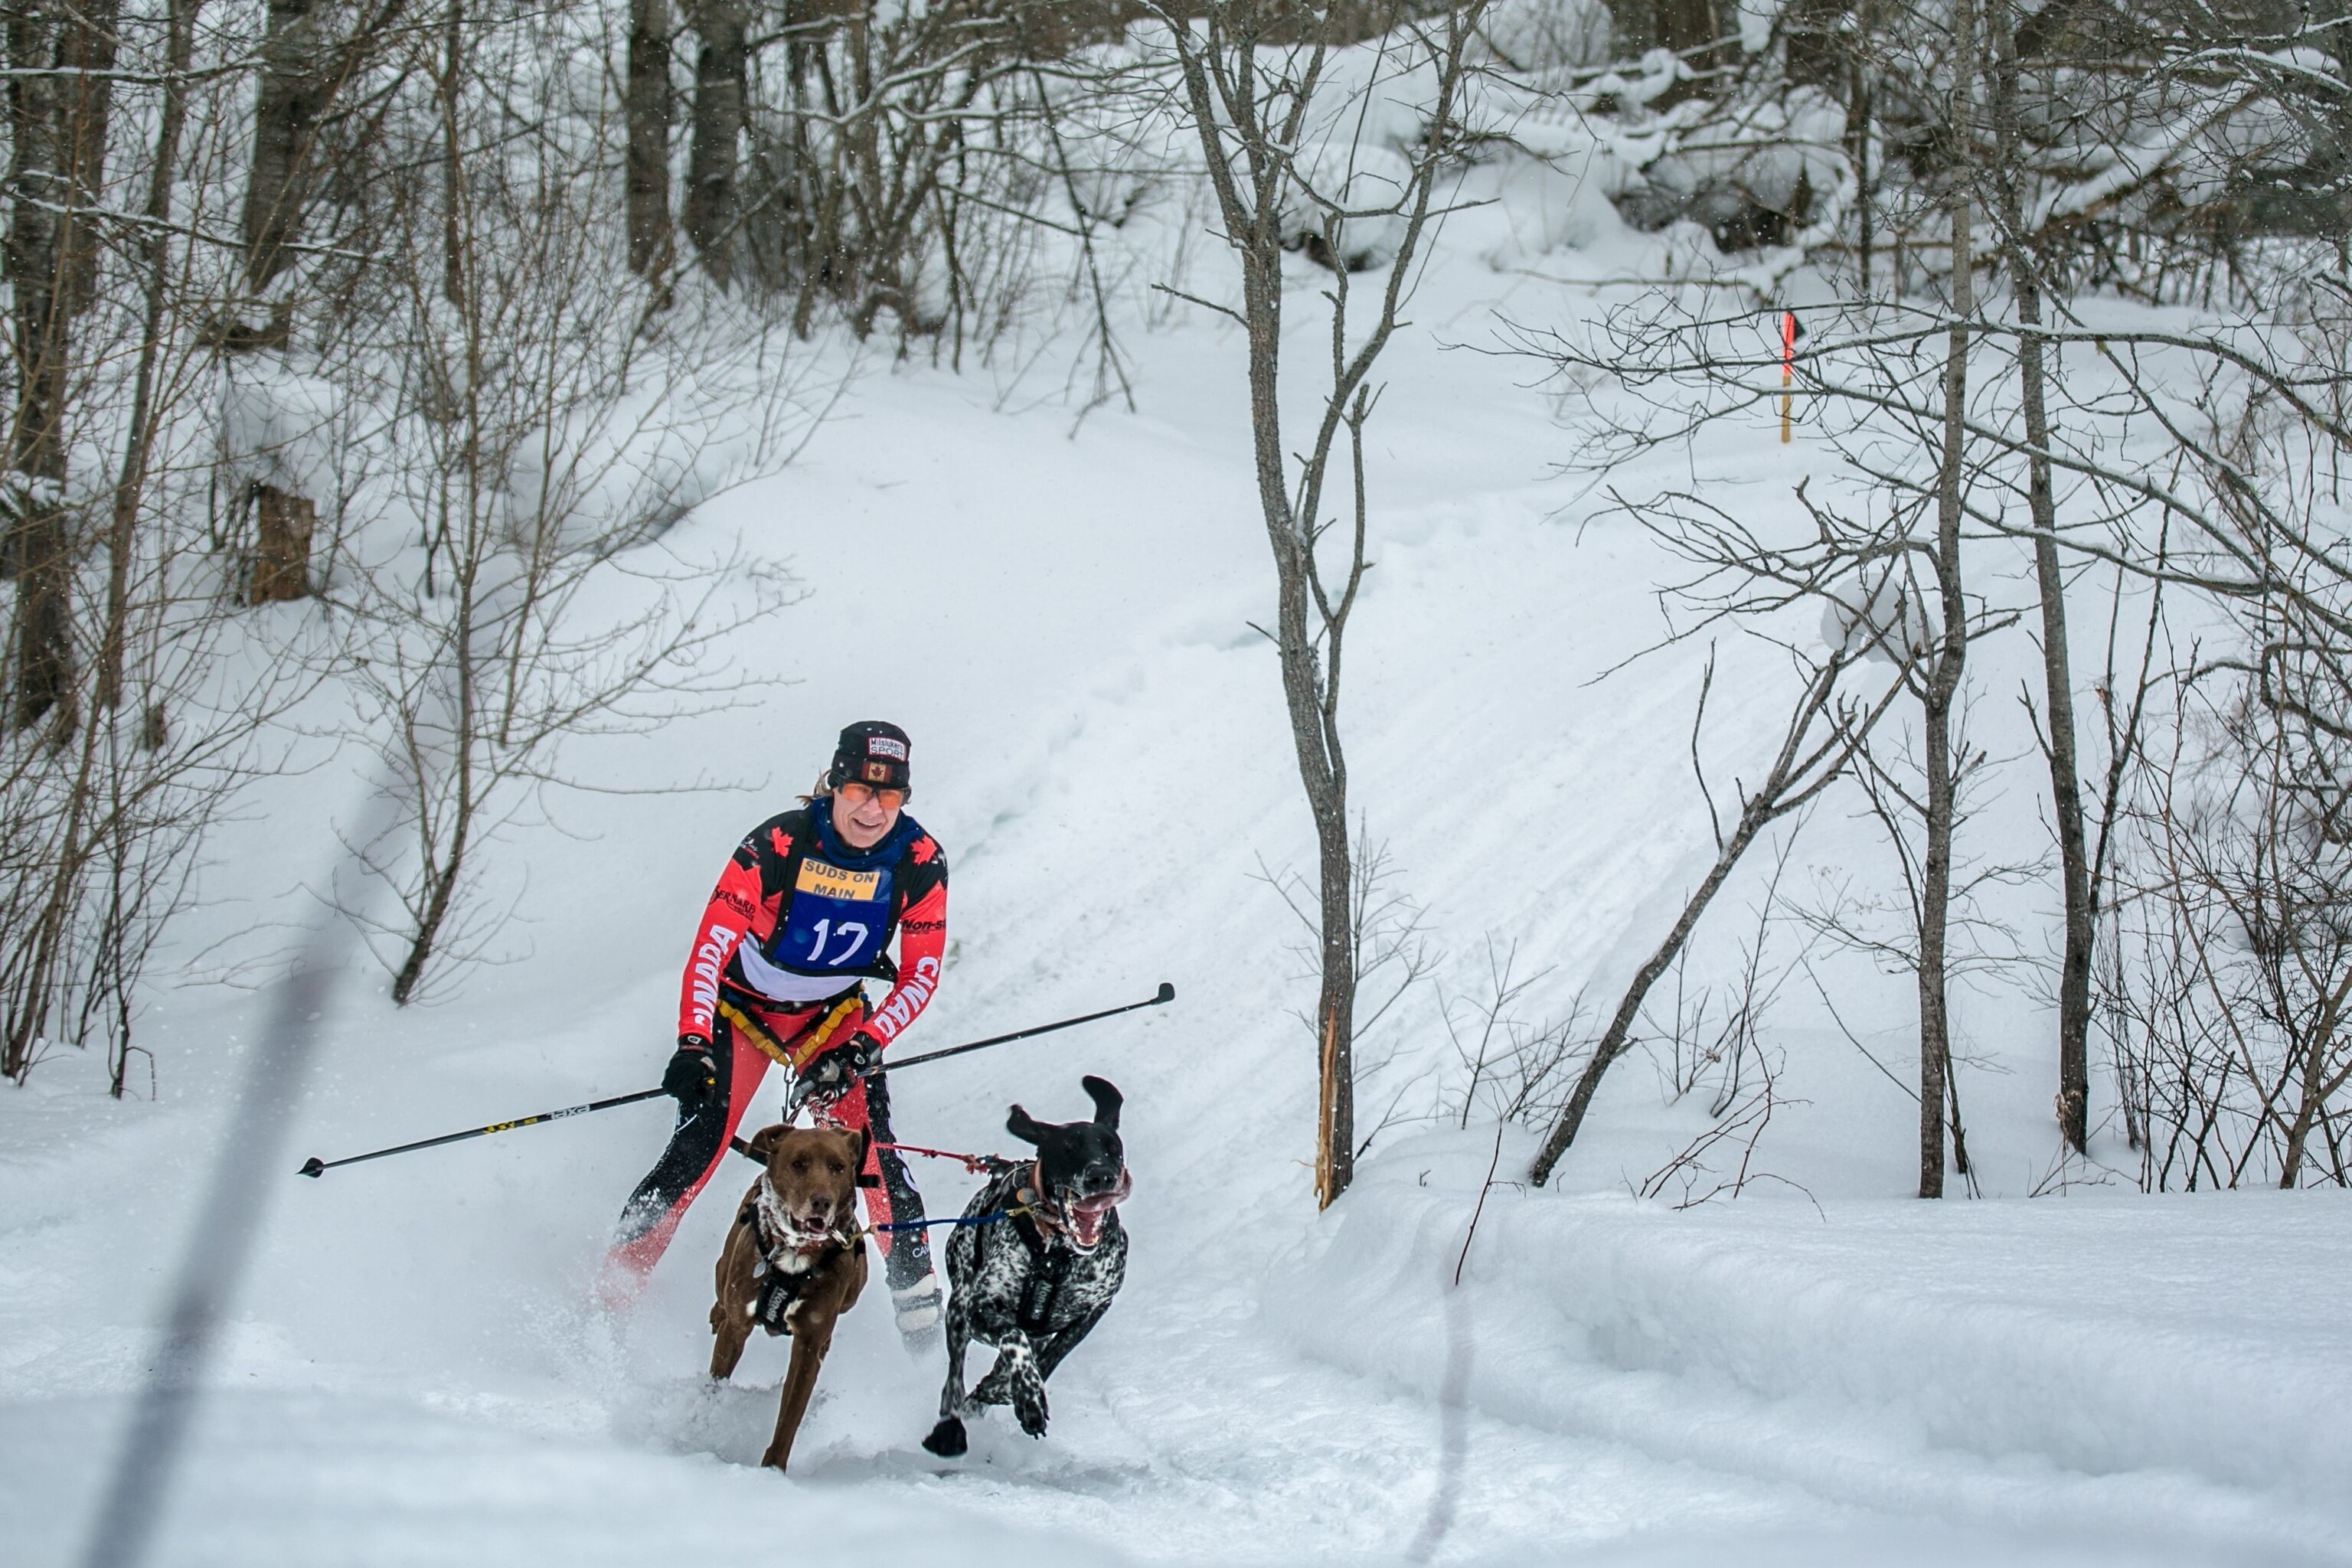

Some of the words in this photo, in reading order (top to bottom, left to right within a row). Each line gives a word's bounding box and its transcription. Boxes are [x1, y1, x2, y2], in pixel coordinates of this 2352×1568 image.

[871, 746, 903, 759] SPORT
[805, 861, 848, 881] SUDS
[853, 873, 874, 884] ON
[813, 884, 856, 900] MAIN
[807, 919, 868, 965] 17
